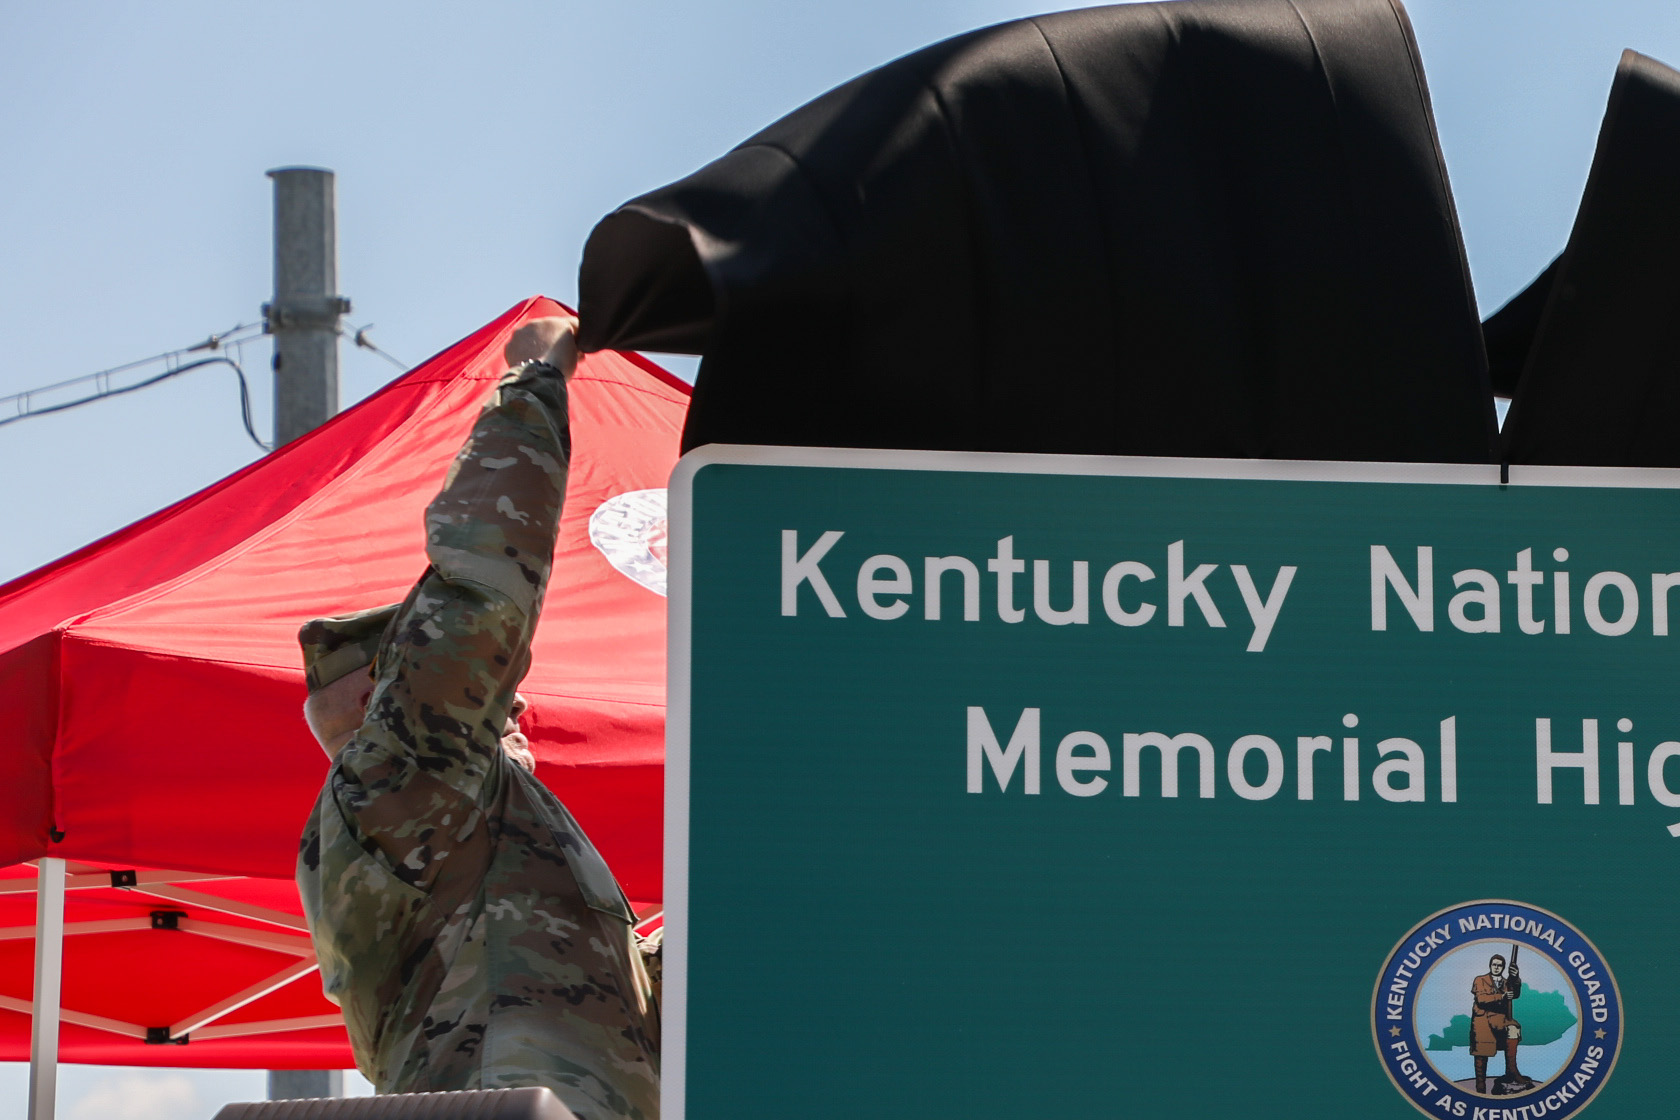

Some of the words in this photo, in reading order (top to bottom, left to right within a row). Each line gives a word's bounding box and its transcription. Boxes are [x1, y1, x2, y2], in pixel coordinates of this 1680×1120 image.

[781, 529, 1298, 652] Kentucky
[966, 706, 1457, 803] Memorial
[1386, 923, 1453, 1021] KENTUCKY
[1458, 912, 1566, 953] NATIONAL
[1567, 950, 1609, 1024] GUARD
[1390, 1040, 1438, 1097] FIGHT
[1435, 1094, 1467, 1117] AS
